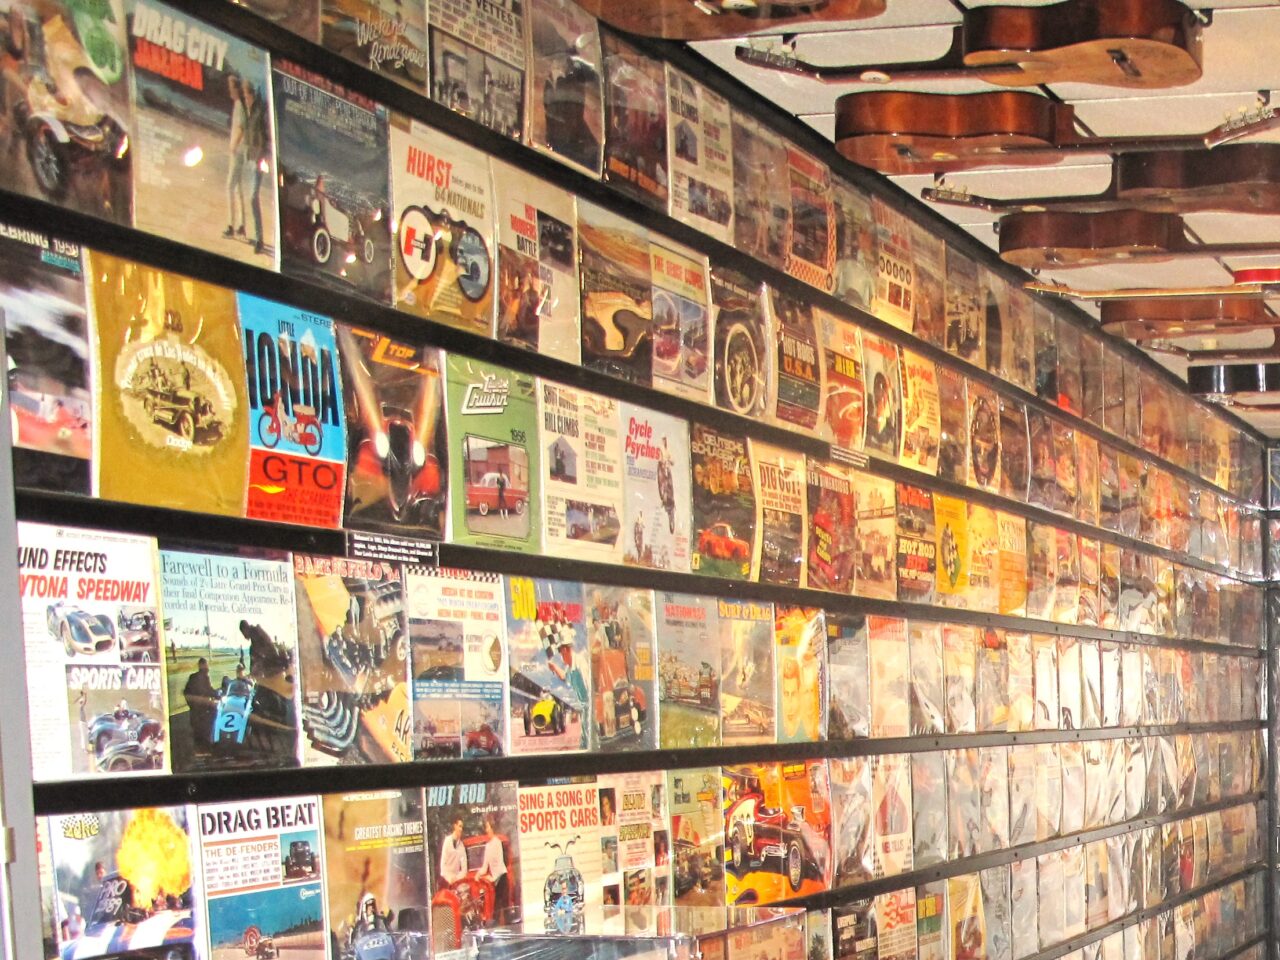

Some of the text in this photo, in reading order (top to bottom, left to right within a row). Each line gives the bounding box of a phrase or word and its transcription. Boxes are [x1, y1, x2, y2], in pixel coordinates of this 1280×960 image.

[133, 3, 187, 54] DRAG
[186, 27, 229, 71] CITY
[406, 145, 453, 190] HURST
[447, 189, 485, 219] NATIONALS
[634, 417, 658, 438] Cycle
[629, 435, 666, 461] Psychos
[262, 455, 339, 490] GTO
[759, 463, 777, 491] DIG
[898, 538, 935, 559] HOT ROD
[53, 549, 107, 574] EFFECTS
[161, 553, 289, 584] Farewell to a Formula
[77, 577, 150, 603] SPEEDWAY
[190, 577, 199, 586] of
[718, 600, 742, 618] SURF
[70, 667, 160, 691] SPORTS CARS
[224, 713, 236, 729] 2
[428, 785, 456, 807] HOT
[460, 782, 486, 805] ROD
[519, 788, 597, 812] SING A SONG OF
[201, 802, 316, 836] DRAG BEAT
[354, 825, 382, 841] GREATEST
[404, 821, 423, 836] THEMES
[520, 809, 567, 833] SPORTS
[570, 807, 598, 828] CARS
[205, 847, 222, 858] THE
